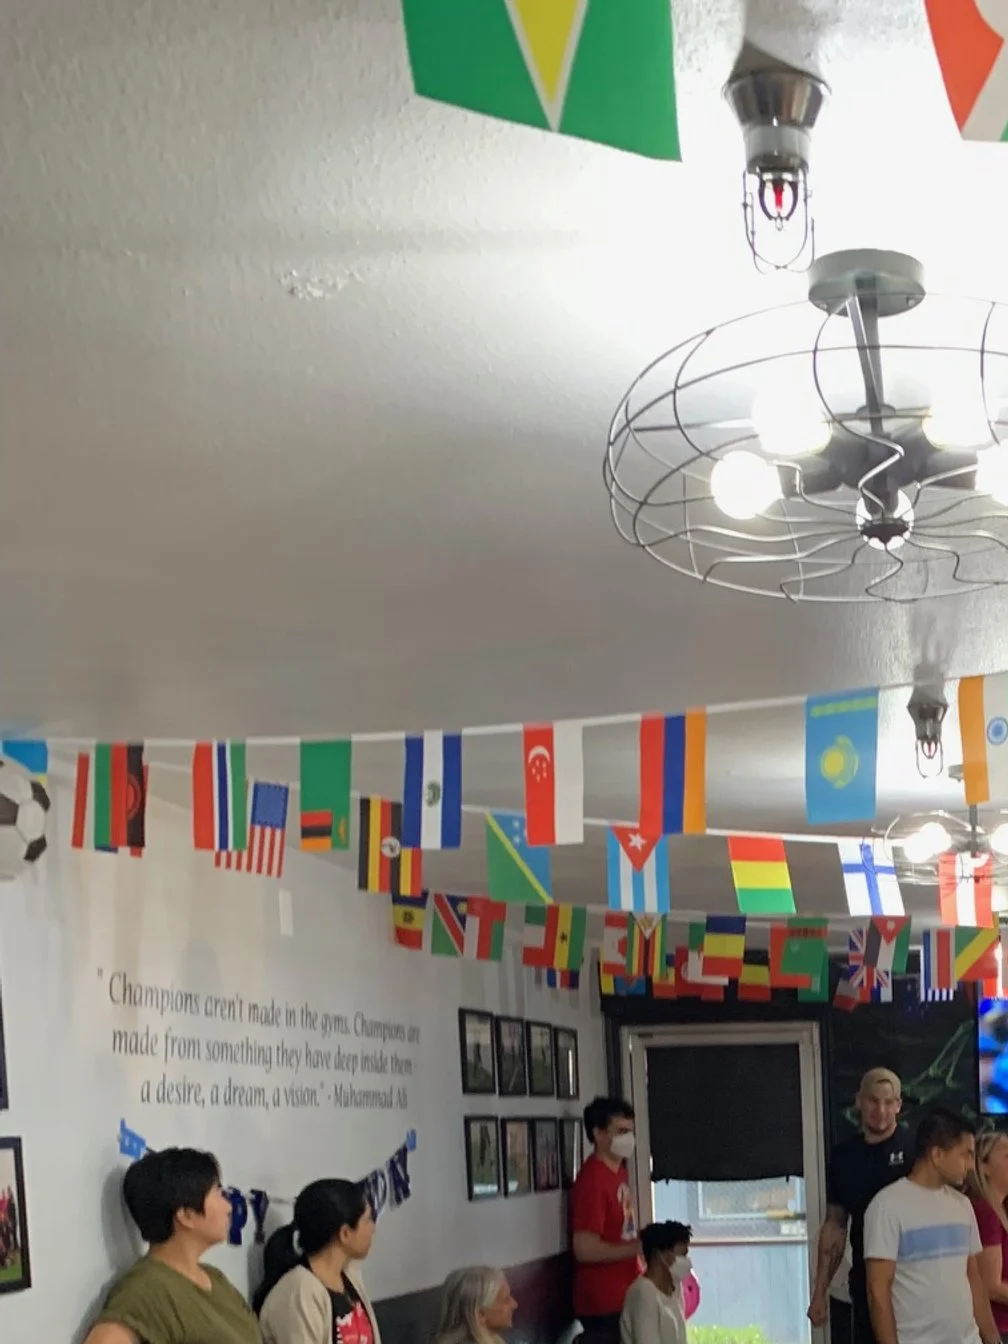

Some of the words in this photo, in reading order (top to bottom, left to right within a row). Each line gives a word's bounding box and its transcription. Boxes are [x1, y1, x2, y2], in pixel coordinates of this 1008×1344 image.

[204, 993, 243, 1022] aren't
[248, 998, 281, 1028] made
[285, 1001, 296, 1028] in
[301, 1002, 318, 1031] the
[321, 1012, 350, 1039] gyms.
[354, 1011, 405, 1043] Champions
[407, 1025, 420, 1044] are
[112, 1024, 158, 1056] made
[164, 1026, 200, 1064] from
[205, 1035, 272, 1074] something
[276, 1038, 300, 1074] they
[305, 1040, 331, 1070] have
[334, 1044, 358, 1076] deep
[361, 1049, 388, 1074] inside
[391, 1052, 412, 1075] them
[141, 1080, 150, 1103] a
[156, 1072, 205, 1109] desire,
[210, 1084, 219, 1106] a
[224, 1076, 269, 1111] dream,
[272, 1086, 280, 1108] a
[334, 1082, 393, 1109] Muhammad
[397, 1084, 408, 1109] Ali
